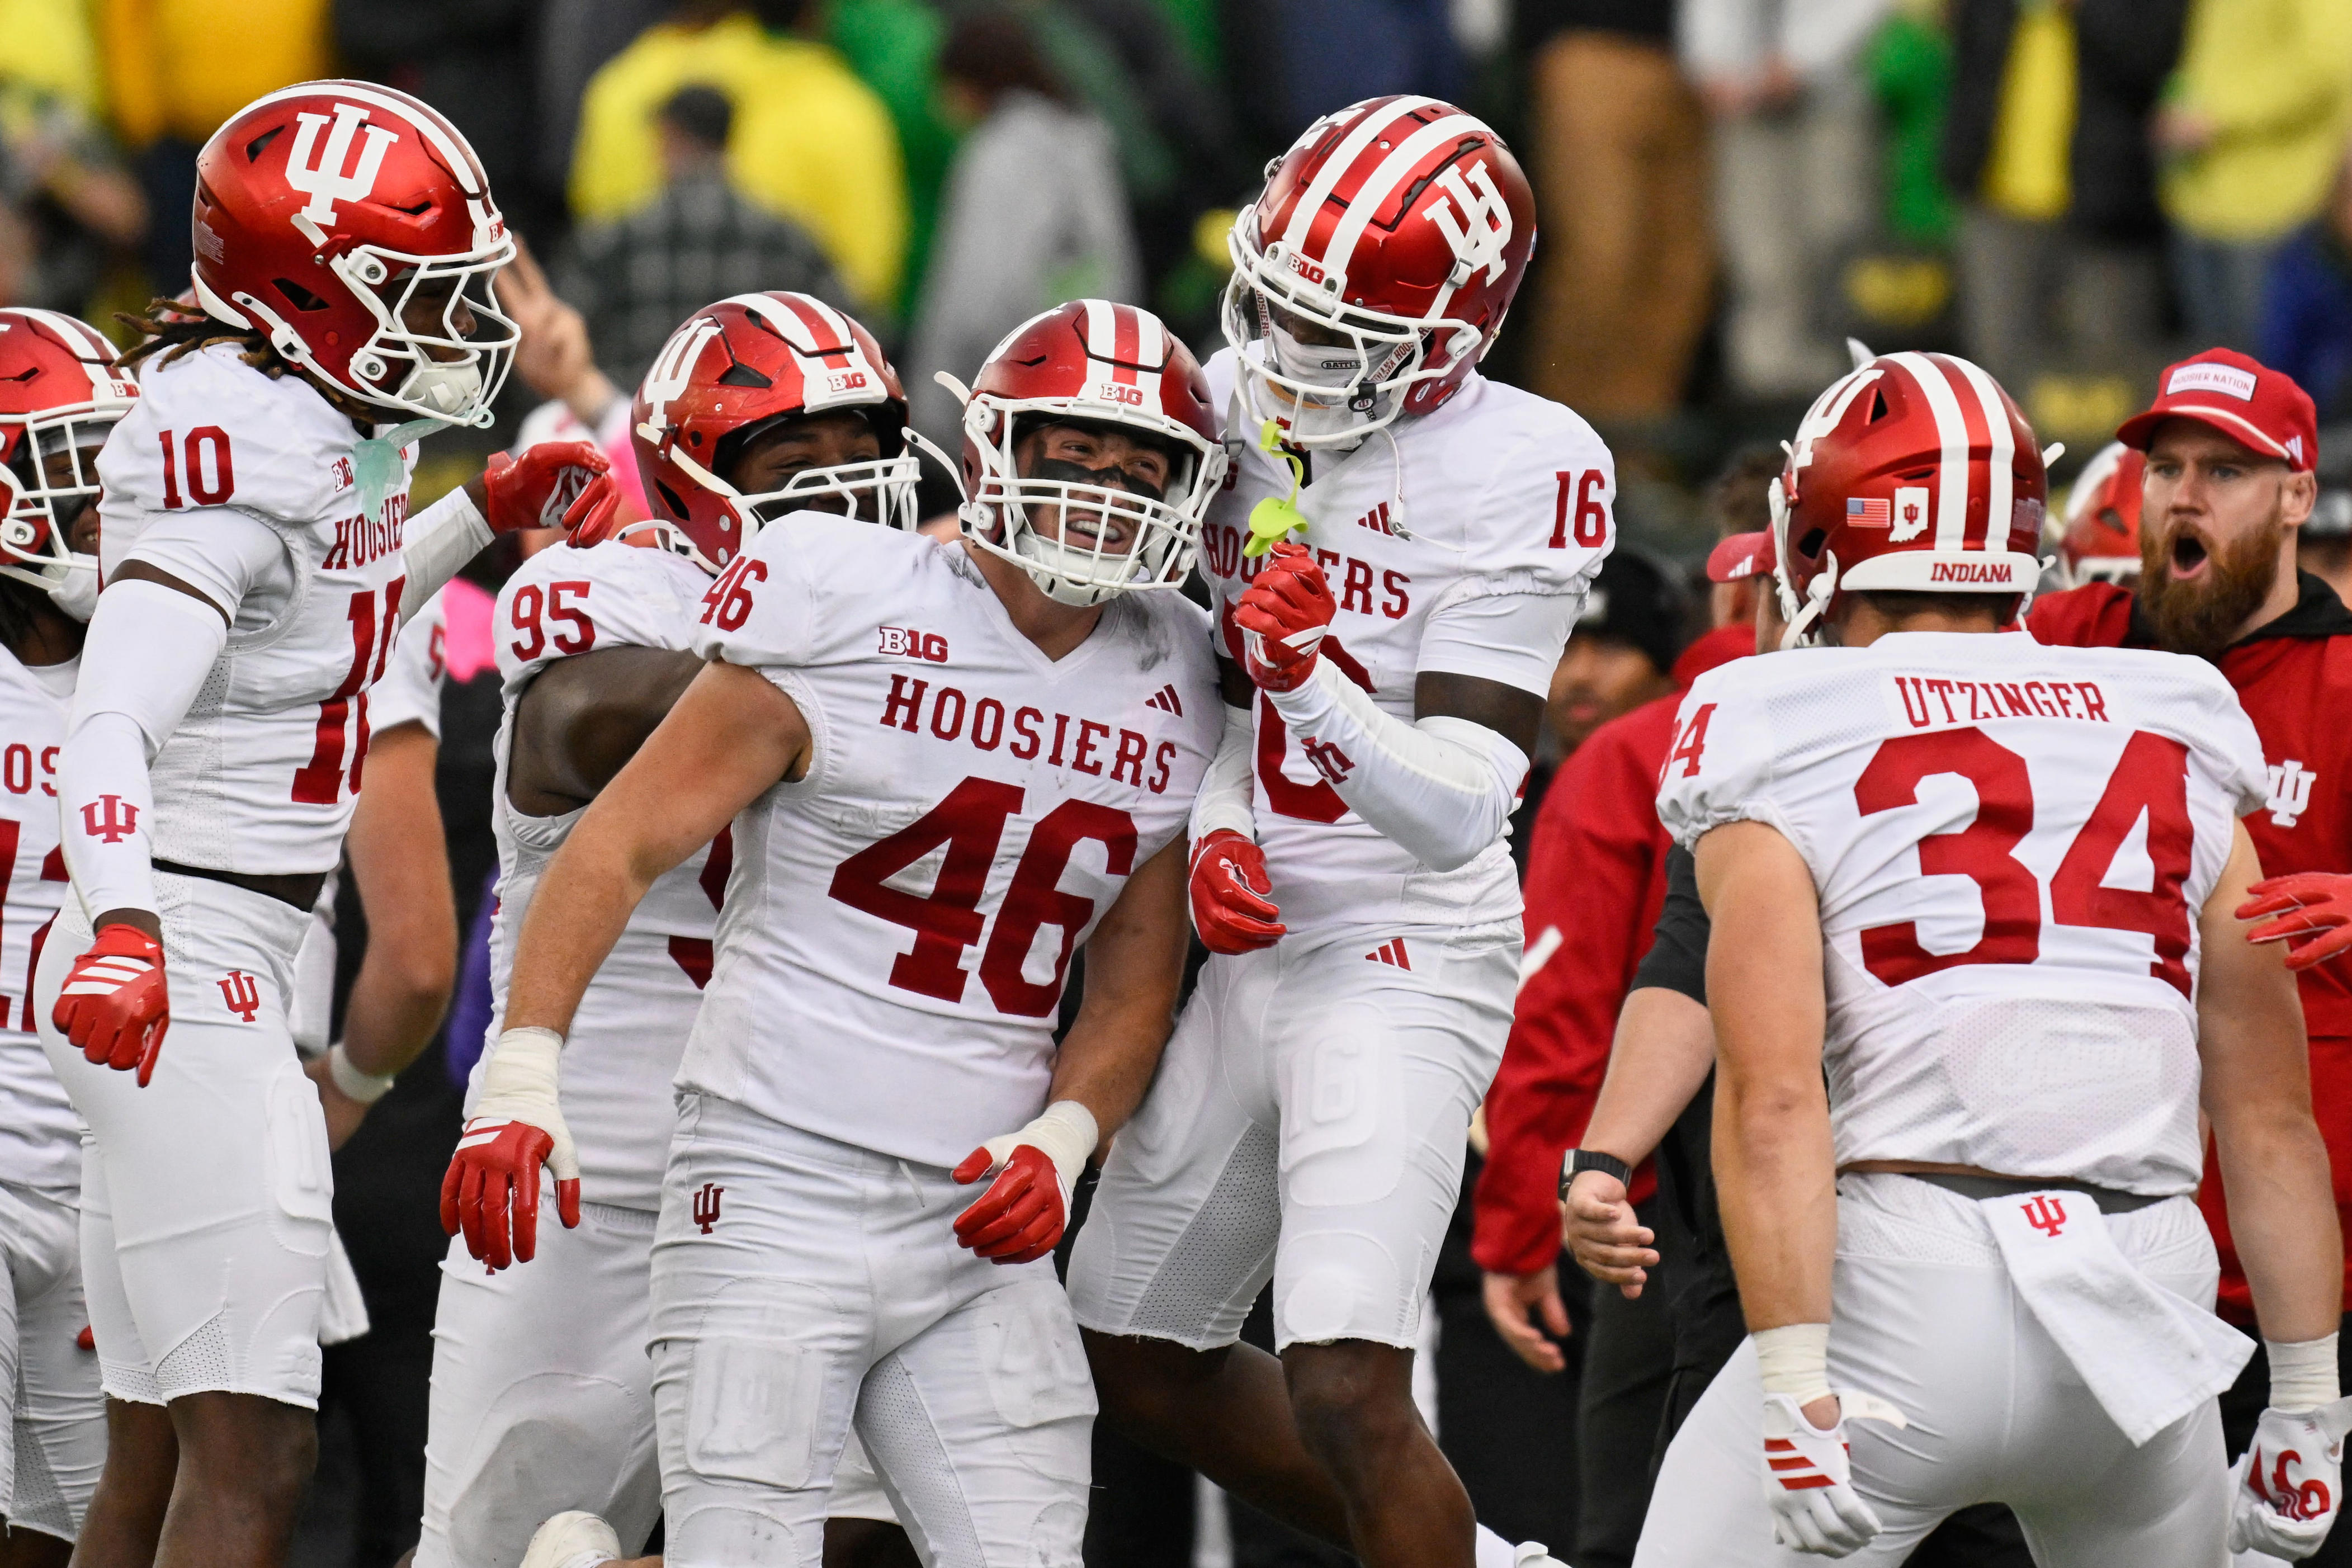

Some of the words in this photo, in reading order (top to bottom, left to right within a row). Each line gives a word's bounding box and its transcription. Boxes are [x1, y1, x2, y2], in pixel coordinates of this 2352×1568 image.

[1256, 289, 1271, 337] OOSIERS
[2172, 372, 2211, 385] HOOSIER
[2213, 374, 2251, 391] NATION
[159, 426, 235, 509] 10
[1548, 469, 1608, 549] 16
[700, 556, 768, 632] 46
[1930, 562, 2012, 583] INDIANA
[512, 581, 596, 662] 95
[880, 673, 1177, 795] HOOSIERS
[1895, 676, 2111, 728] UTZINGER
[828, 776, 1138, 1018] 46
[1854, 727, 2194, 1004] 34
